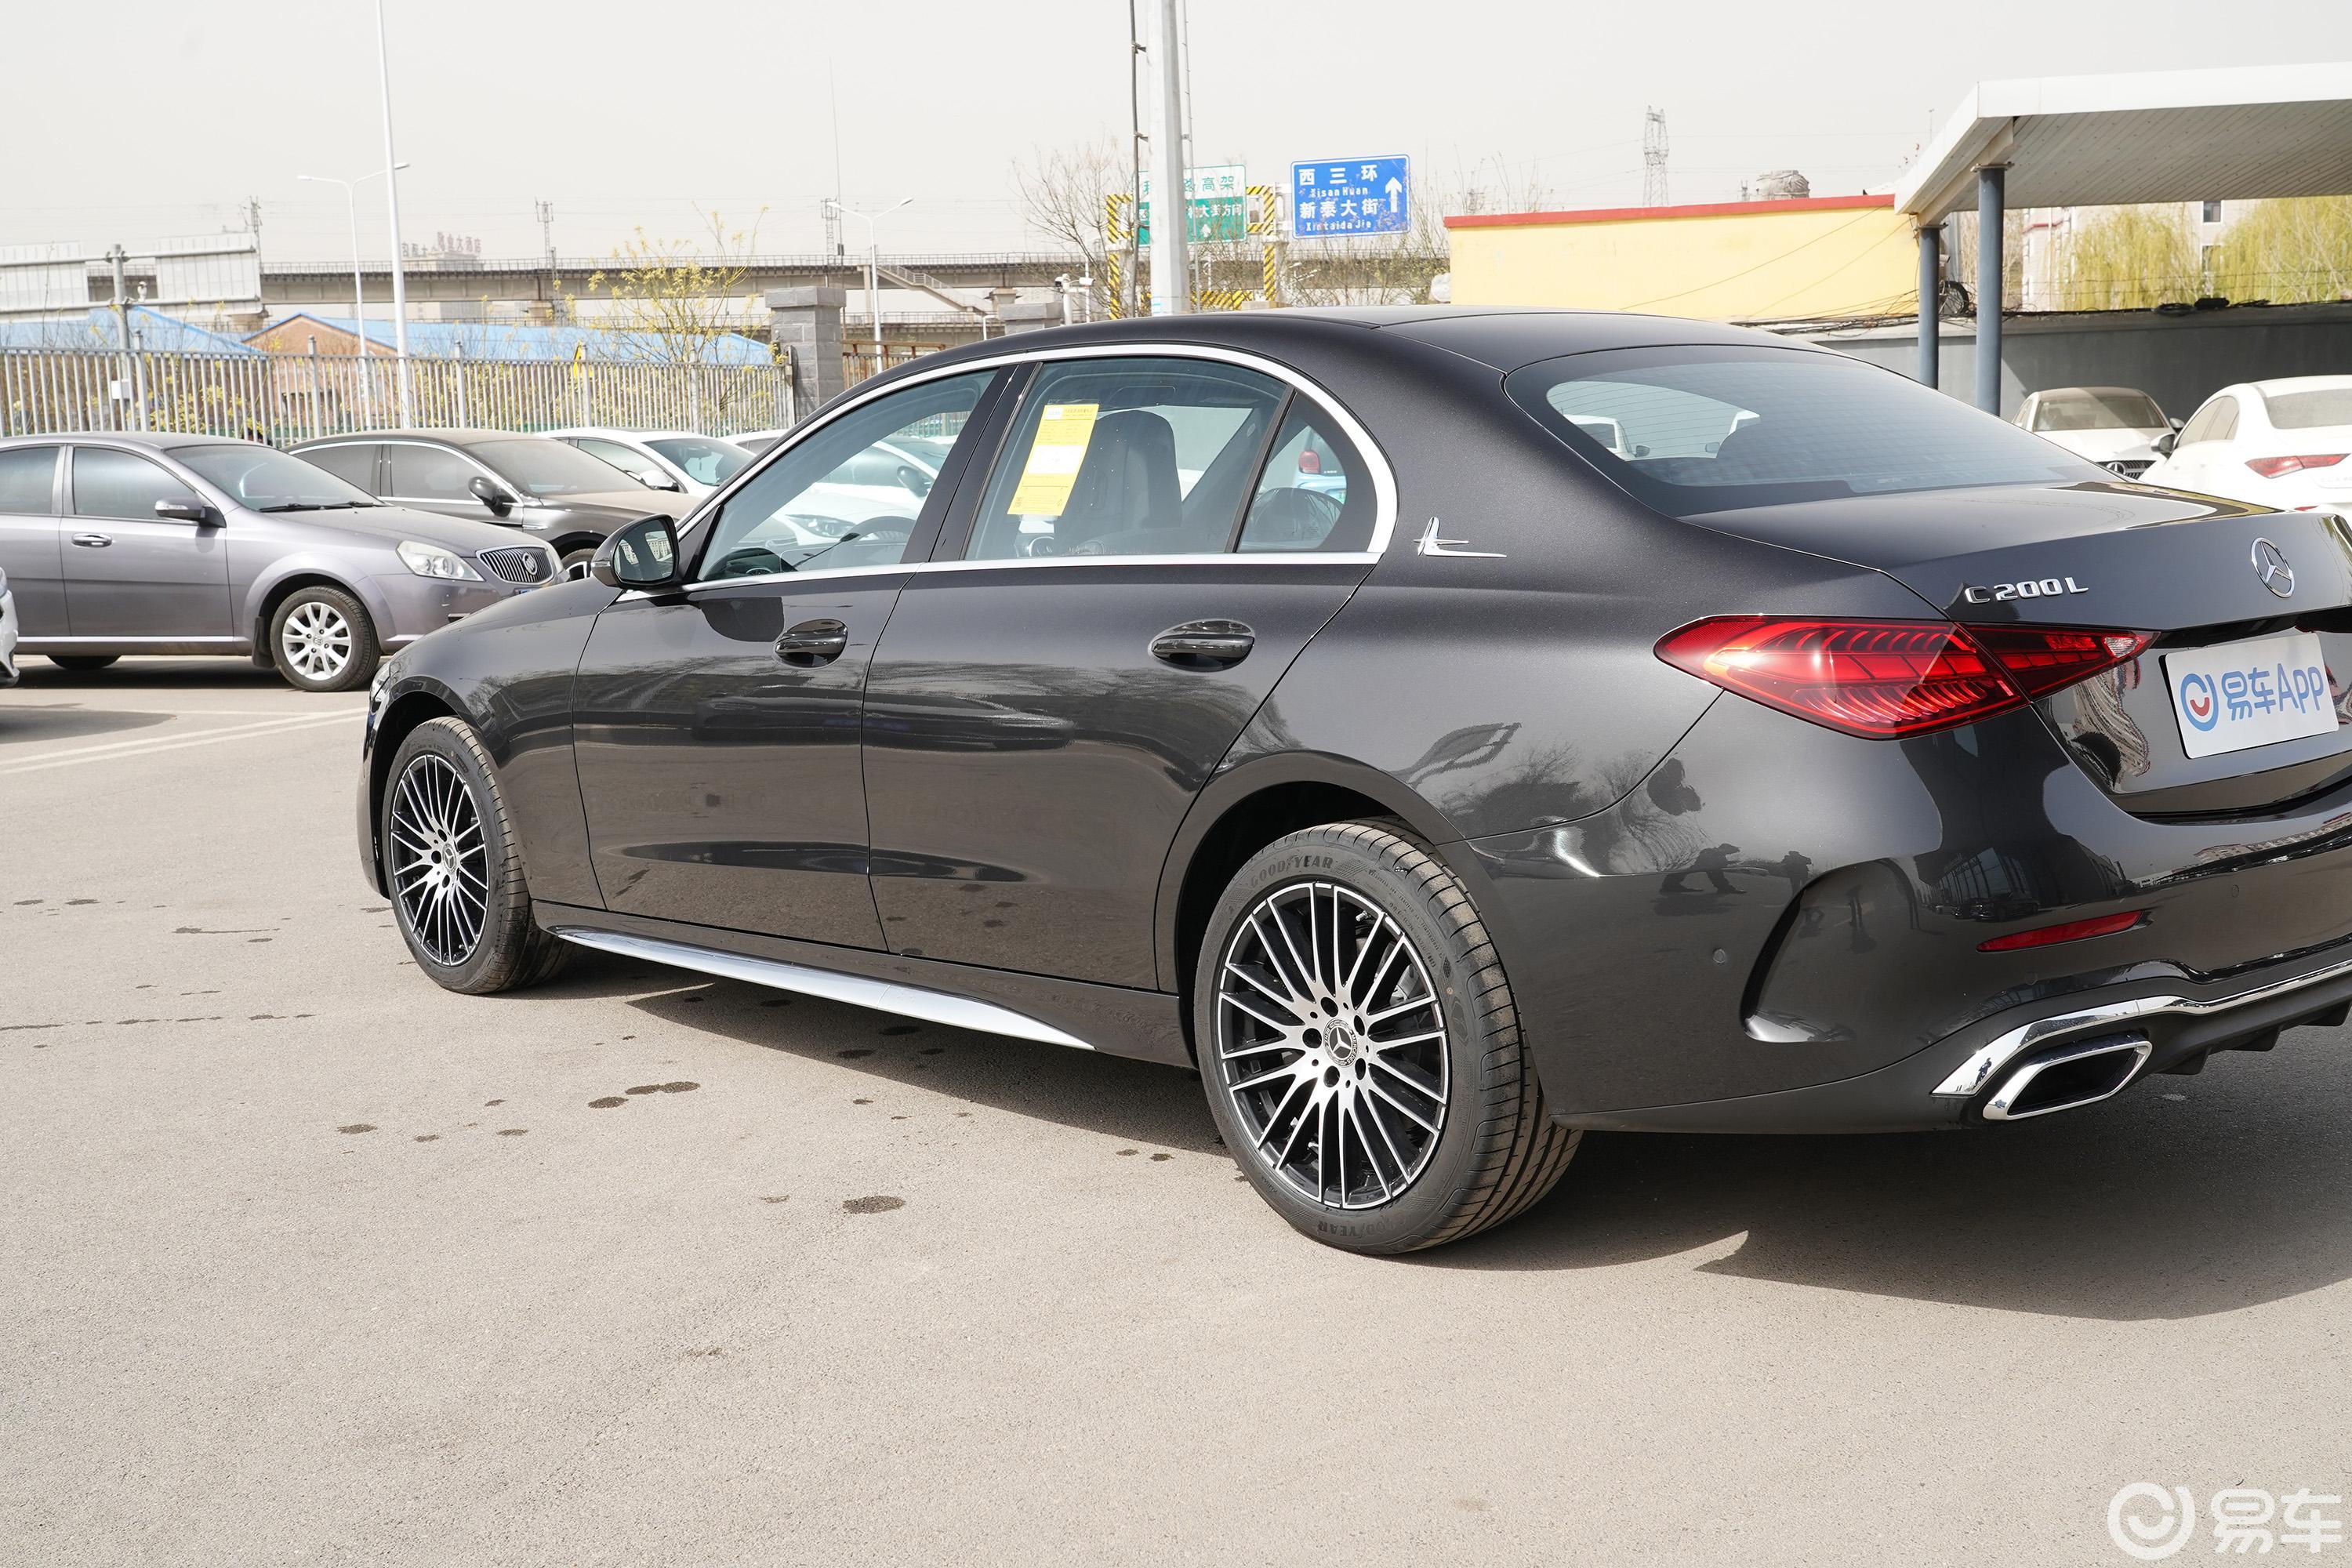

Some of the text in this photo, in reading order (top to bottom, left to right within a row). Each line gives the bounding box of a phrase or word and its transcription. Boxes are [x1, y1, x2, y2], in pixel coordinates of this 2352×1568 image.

[1298, 164, 1377, 186] 西三环
[1342, 187, 1368, 196] Huan
[1299, 198, 1378, 219] 新泰大街
